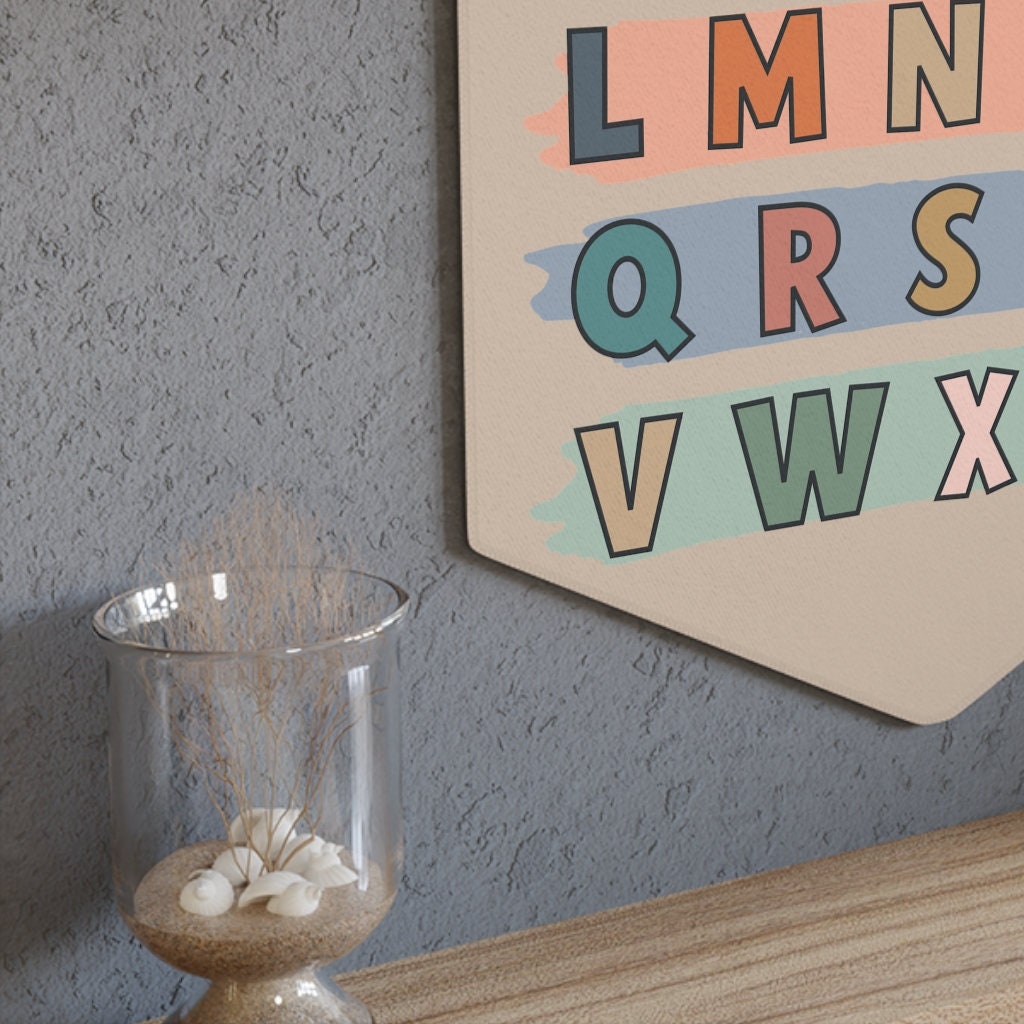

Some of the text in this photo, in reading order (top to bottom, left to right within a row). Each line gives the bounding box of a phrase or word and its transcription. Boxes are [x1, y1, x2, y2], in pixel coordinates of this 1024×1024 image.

[566, 26, 645, 166] L
[707, 7, 827, 151] M
[570, 218, 696, 363] Q
[757, 201, 847, 338] R
[905, 182, 985, 317] S
[573, 412, 684, 559] V
[730, 381, 891, 532] W
[933, 366, 1020, 502] X
